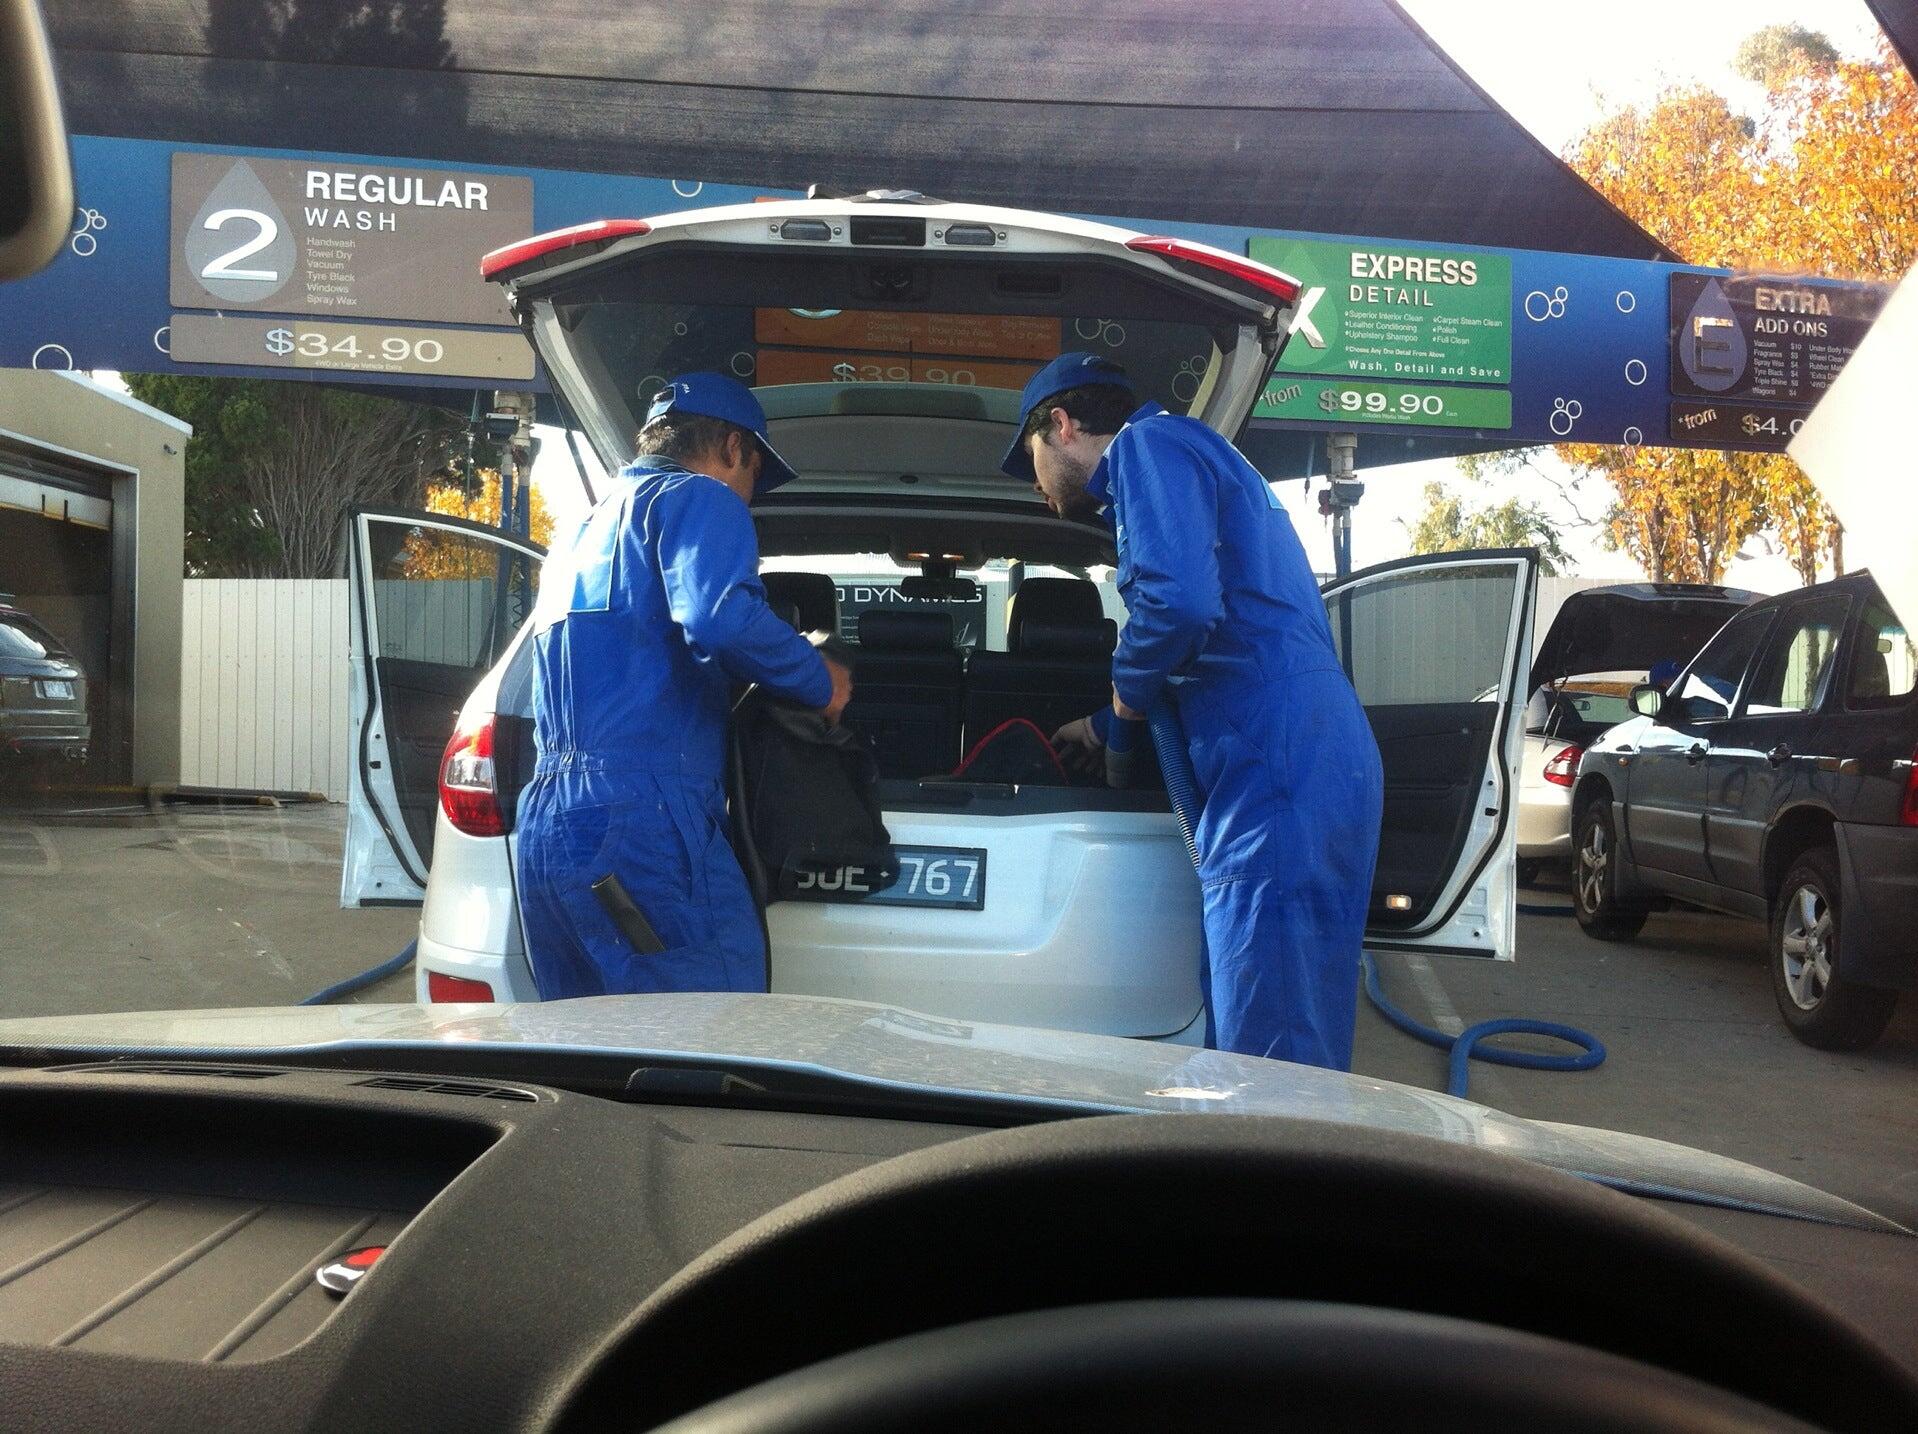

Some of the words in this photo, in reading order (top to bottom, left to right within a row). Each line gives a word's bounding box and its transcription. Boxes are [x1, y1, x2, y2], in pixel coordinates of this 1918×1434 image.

[306, 170, 488, 211] REGULAR
[304, 206, 396, 232] WASH
[202, 208, 278, 282] 2
[306, 236, 356, 248] Handwash
[307, 248, 334, 258] Towel
[336, 250, 353, 261] Dry
[306, 259, 344, 270] Vacuum
[1351, 252, 1478, 286] EXPRESS
[306, 271, 327, 281] Tyre
[329, 272, 356, 282] Black
[306, 283, 349, 293] Windows
[306, 294, 334, 306] Spray
[336, 296, 357, 306] Wax
[1350, 284, 1434, 307] DETAIL
[1755, 287, 1832, 316] EXTRA
[1349, 309, 1377, 319] Superior
[1379, 312, 1402, 321] Interior
[1403, 313, 1424, 322] Clean
[1460, 316, 1482, 326] Steam
[1483, 318, 1503, 327] Clean
[1349, 320, 1374, 329] Leather
[1375, 321, 1418, 333] Conditioning
[1437, 325, 1457, 334] Polish
[1754, 317, 1789, 335] ADD
[1792, 319, 1828, 338] ONS
[1349, 330, 1385, 341] Upholstery
[1386, 332, 1418, 342] Shampoo
[1437, 335, 1450, 344] Full
[1450, 336, 1470, 345] Clean
[265, 328, 444, 363] $34.90
[1693, 317, 1734, 375] E
[1753, 339, 1777, 348] Vacuum
[1348, 360, 1388, 373] Wash,
[1395, 362, 1434, 374] Detail
[1440, 365, 1464, 375] and
[1470, 366, 1501, 377] Save
[1318, 388, 1444, 415] $99.90
[899, 857, 979, 897] 767
